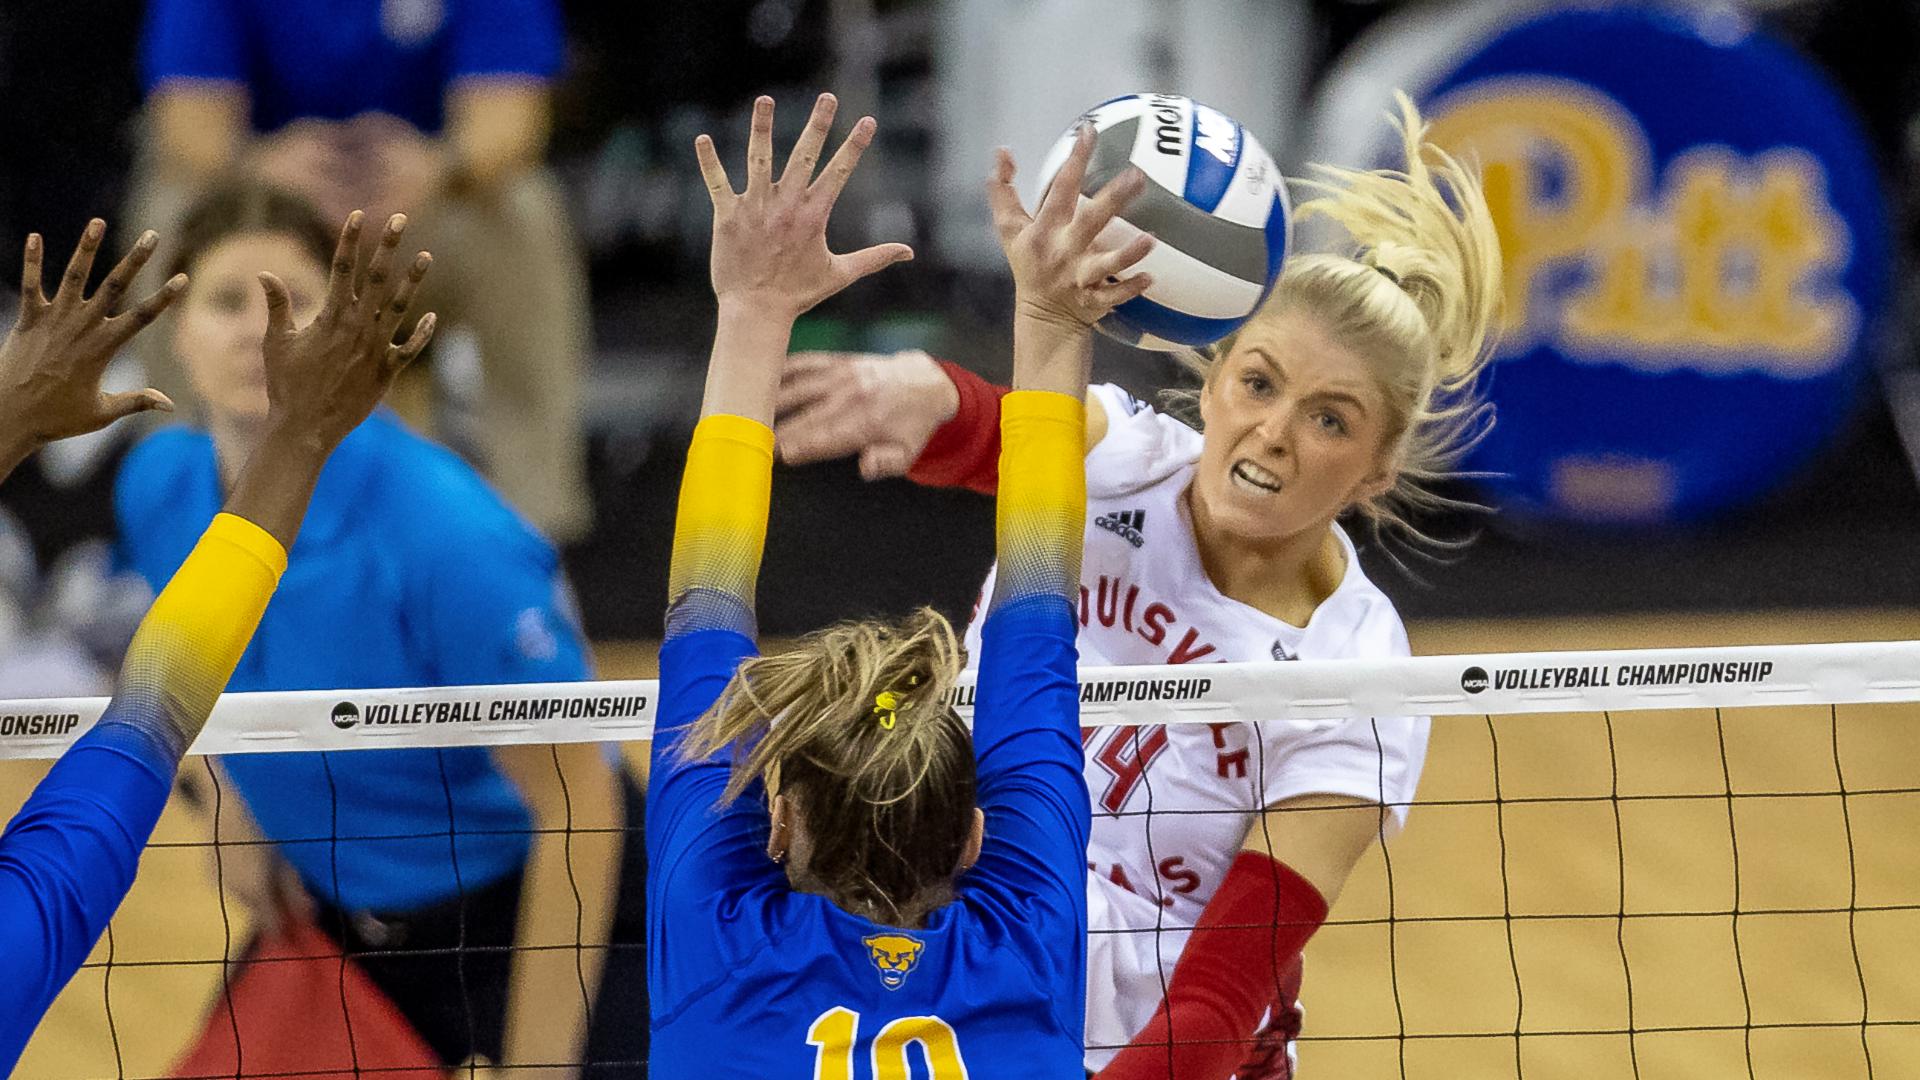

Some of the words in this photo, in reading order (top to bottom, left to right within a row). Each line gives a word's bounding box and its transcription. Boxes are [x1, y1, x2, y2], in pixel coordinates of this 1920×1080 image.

[1416, 76, 1856, 375] Pitt
[1095, 516, 1145, 548] adidas
[1494, 666, 1610, 690] VOLLEYBALL
[1617, 661, 1774, 686] CHAMPIONSHIP
[1078, 678, 1212, 703] AMPIONSHIP
[0, 713, 79, 736] ONSHIP
[364, 702, 482, 725] VOLLEYBALL
[489, 696, 647, 720] CHAMPIONSHIP
